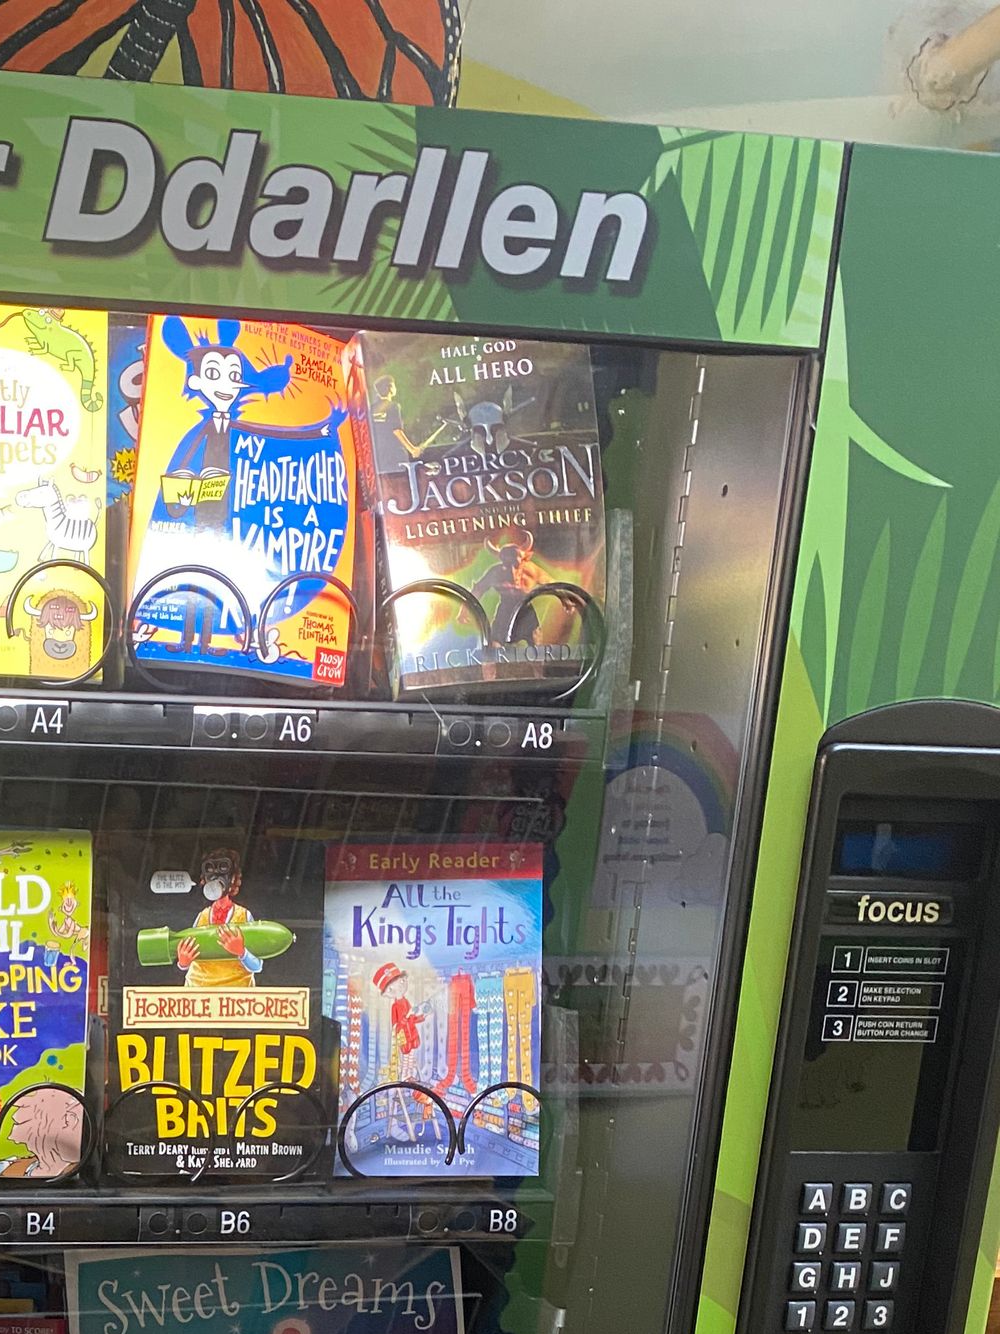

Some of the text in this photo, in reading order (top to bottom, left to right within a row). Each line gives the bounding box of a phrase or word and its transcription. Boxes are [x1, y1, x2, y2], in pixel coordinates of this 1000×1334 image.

[44, 116, 651, 283] Ddarllen
[441, 340, 516, 359] HALF GOD
[301, 354, 333, 375] PAMELA
[429, 358, 533, 386] ALL HERO
[295, 363, 338, 389] BUTCHART
[235, 434, 265, 463] MY
[440, 448, 534, 476] PERCY
[202, 480, 226, 491] SCHOOL
[233, 450, 347, 513] HEADTEACHER
[388, 443, 599, 515] JACKSON
[201, 489, 223, 500] RULES
[264, 505, 319, 528] IS A
[406, 508, 592, 540] LIGHTNING THIEF
[232, 517, 343, 575] VAMPIRE
[298, 628, 337, 645] FLINTHAM
[302, 617, 335, 635] THOMAS
[317, 664, 343, 678] crow
[320, 652, 344, 669] nosy
[415, 649, 483, 672] RICK
[31, 706, 64, 735] A4
[279, 714, 312, 742] A6
[521, 722, 553, 749] A8
[369, 851, 500, 873] Early Reader
[382, 883, 461, 908] All the
[857, 894, 941, 923] focus
[352, 904, 528, 960] King's Tights
[844, 951, 852, 968] 1
[867, 956, 892, 964] INSERT
[923, 957, 942, 965] SLOT
[837, 985, 922, 1002] 2 MAKE SELECTION
[861, 995, 901, 1003] ON KEYPAD
[135, 997, 298, 1018] HORRIBLE HISTORIES
[832, 1020, 843, 1036] 3
[858, 1020, 877, 1028] PUSH
[895, 1021, 923, 1029] RETURN
[856, 1029, 929, 1038] BUTTON FOR CHANGE
[116, 1033, 317, 1098] BLITZED
[155, 1097, 278, 1138] BRITS
[127, 1142, 302, 1155] TERRY DEARY MARTIN BROWN
[384, 1144, 431, 1155] Maudie
[176, 1156, 184, 1167] &
[384, 1157, 429, 1166] Illustrated
[430, 1158, 440, 1167] by
[808, 1188, 907, 1210] A B C
[27, 1212, 55, 1235] B4
[220, 1211, 251, 1234] B6
[489, 1210, 518, 1233] B8
[803, 1228, 900, 1249] D E F
[798, 1267, 894, 1288] G H J
[252, 1260, 446, 1330] Dreams
[797, 1306, 887, 1327] 1 2 3
